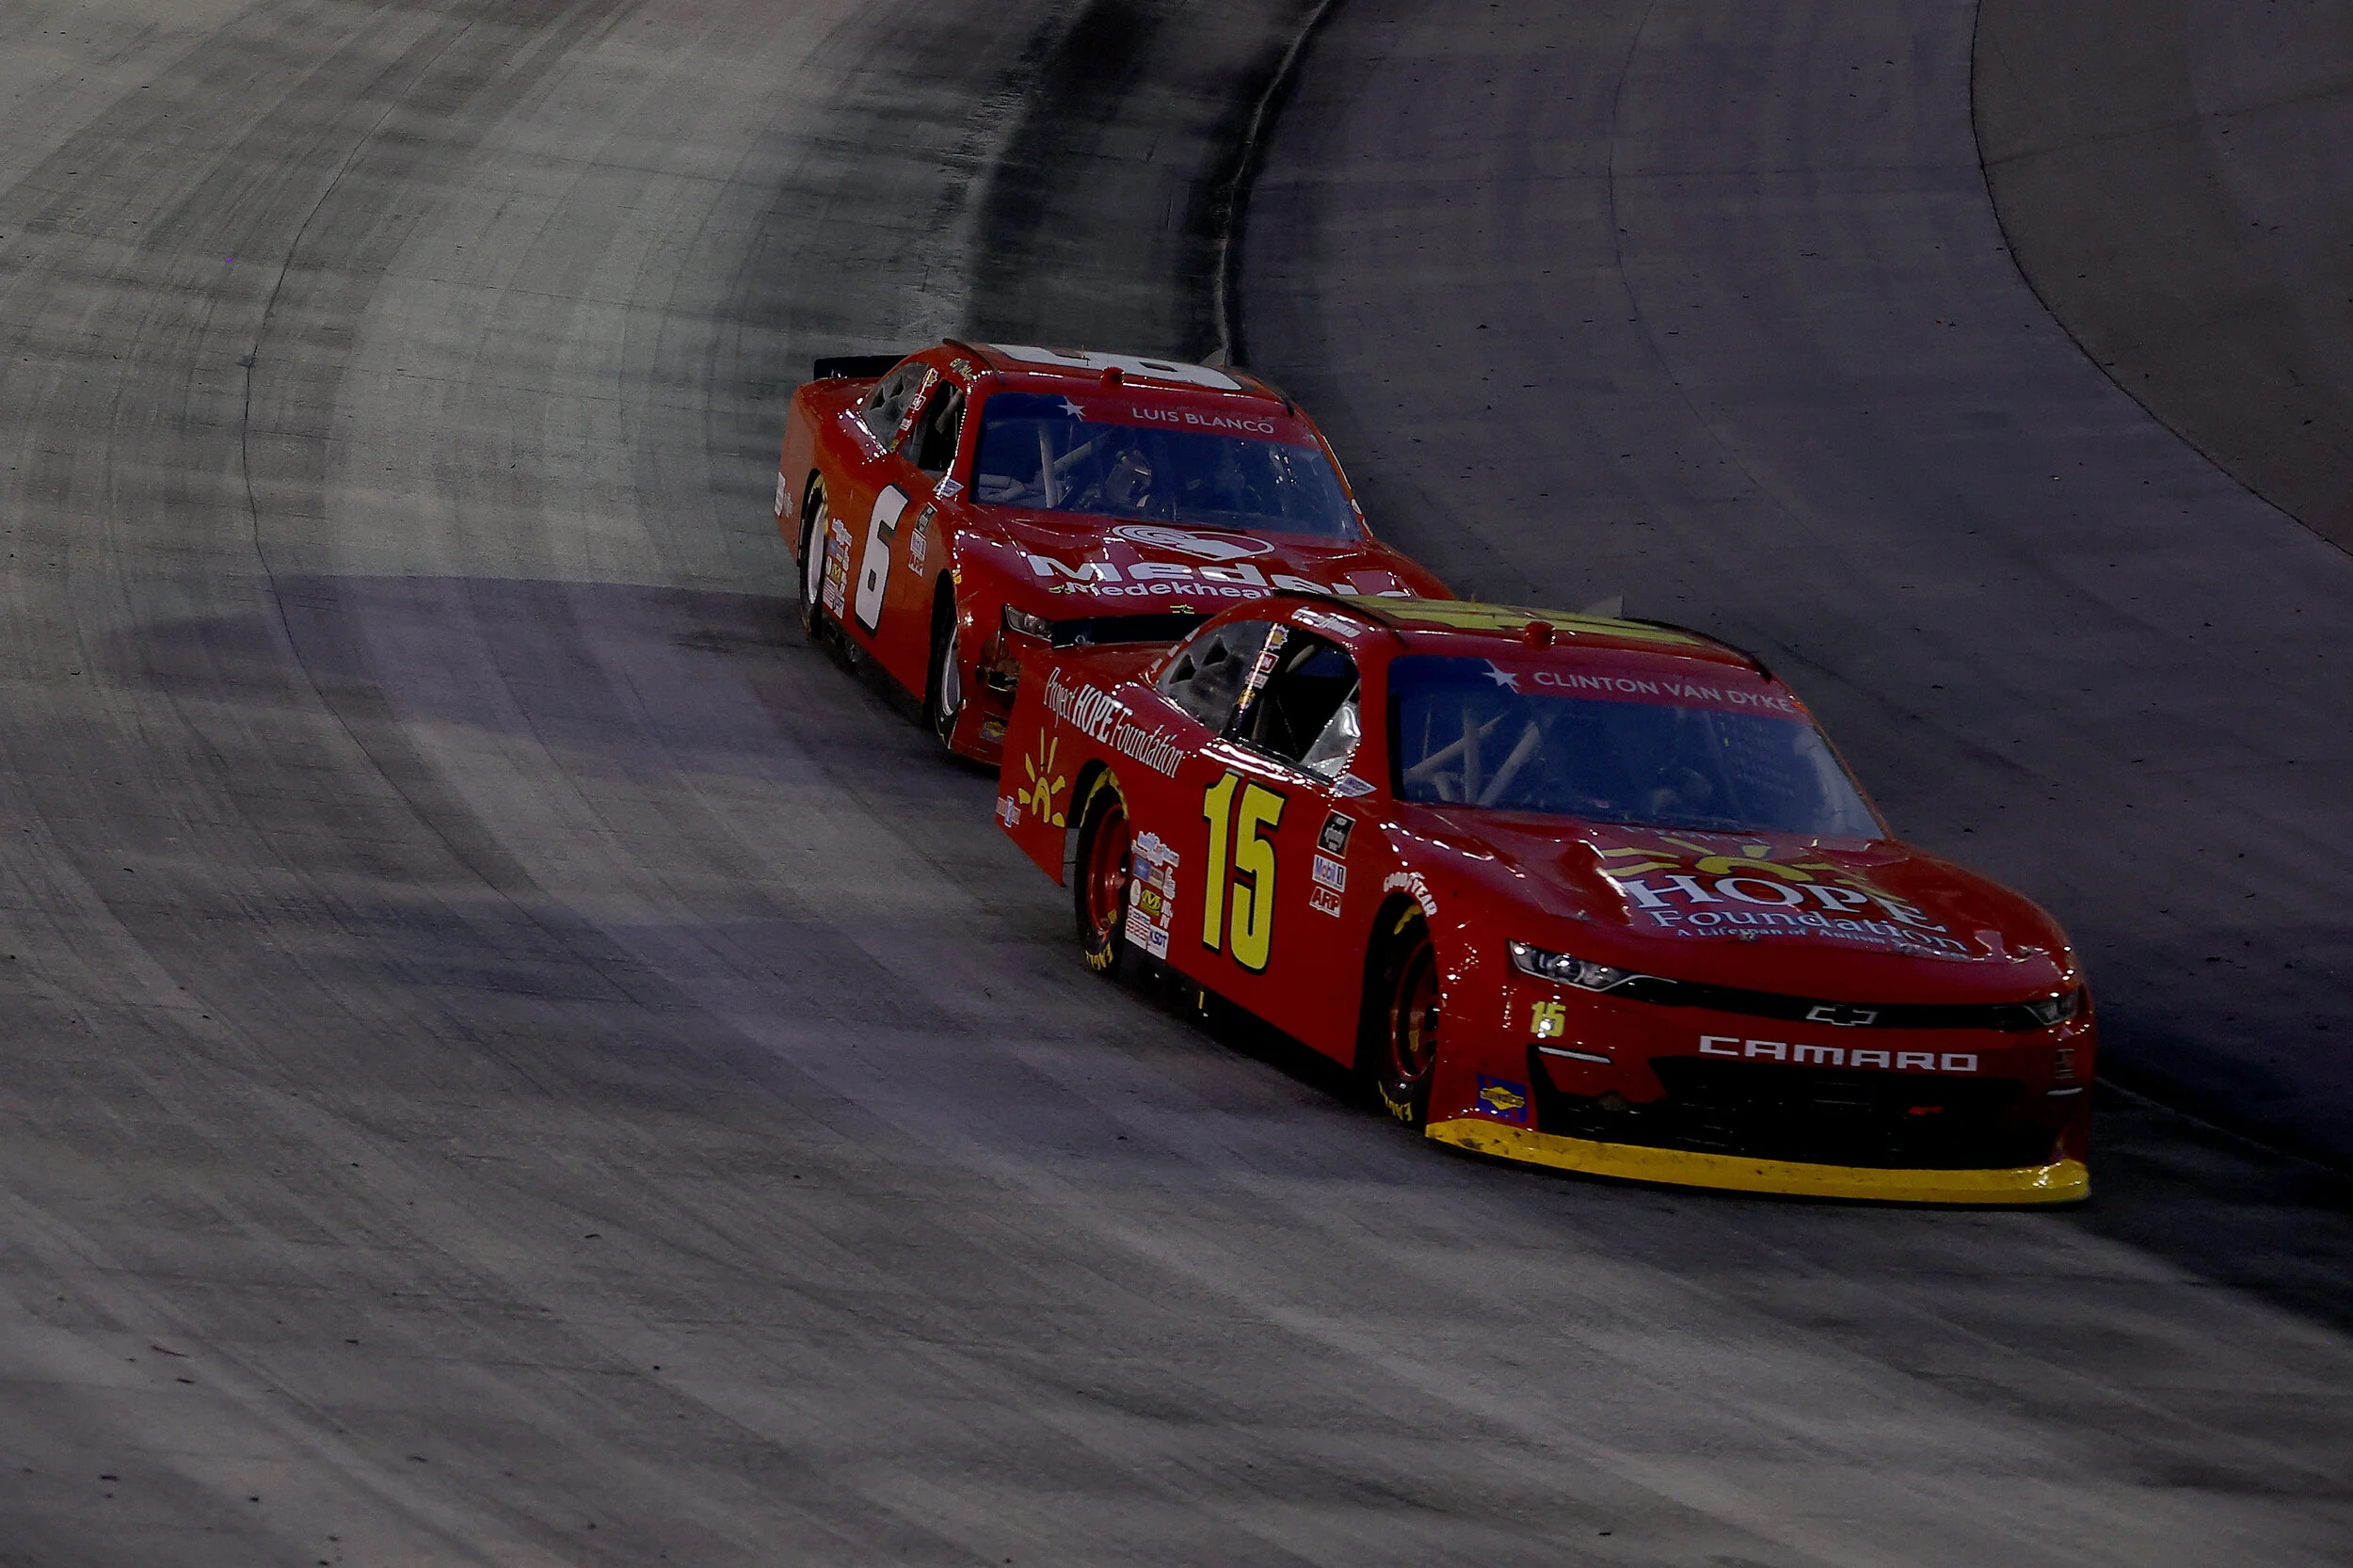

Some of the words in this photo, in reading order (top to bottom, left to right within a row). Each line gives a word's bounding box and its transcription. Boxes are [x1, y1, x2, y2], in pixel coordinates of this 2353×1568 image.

[1131, 407, 1179, 424] LUIS
[1184, 412, 1275, 435] BLANCO
[856, 483, 911, 636] 6
[1532, 671, 1659, 696] CLINTON
[1662, 681, 1722, 702] VAN
[1724, 690, 1796, 714] DYKE
[1043, 666, 1080, 729] Project
[1070, 683, 1124, 744] HOPE
[1109, 707, 1185, 778] Foundation
[1203, 768, 1287, 975] 15
[1623, 874, 1947, 933] HOPE
[1649, 908, 1970, 952] Foundation
[1530, 1000, 1567, 1037] 15
[1698, 1034, 1978, 1072] CAMARO
